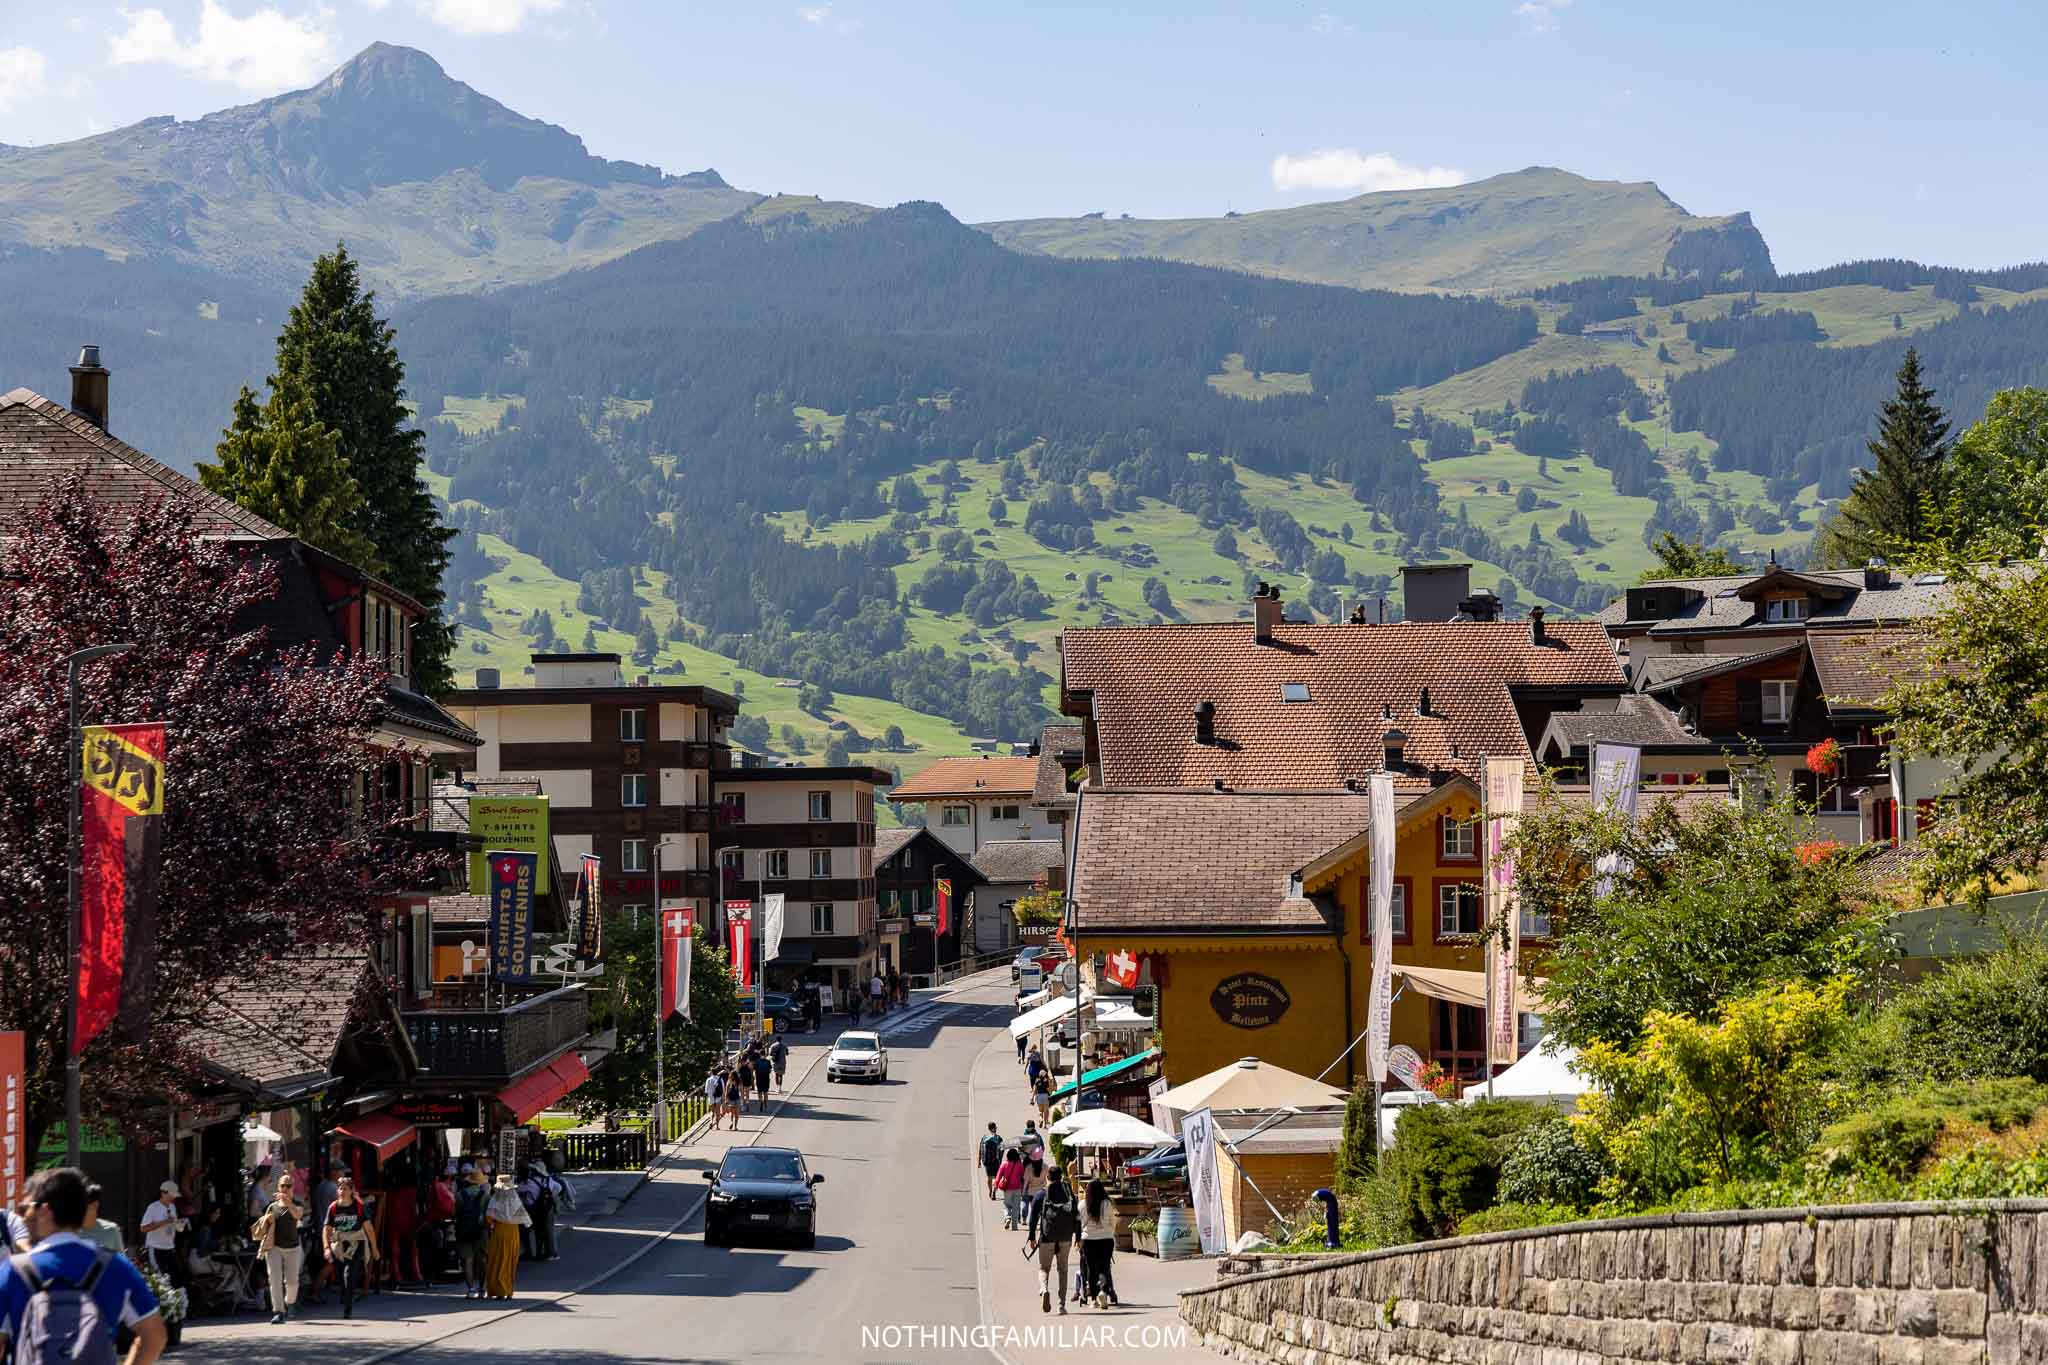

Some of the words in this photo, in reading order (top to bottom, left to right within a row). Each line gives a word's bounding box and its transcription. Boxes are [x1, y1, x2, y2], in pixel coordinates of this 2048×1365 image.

[483, 823, 536, 831] T-SHIRTS
[496, 887, 512, 975] T-SHIRTS
[511, 865, 530, 976] SOUVENIRS
[1231, 992, 1270, 1009] Pinte
